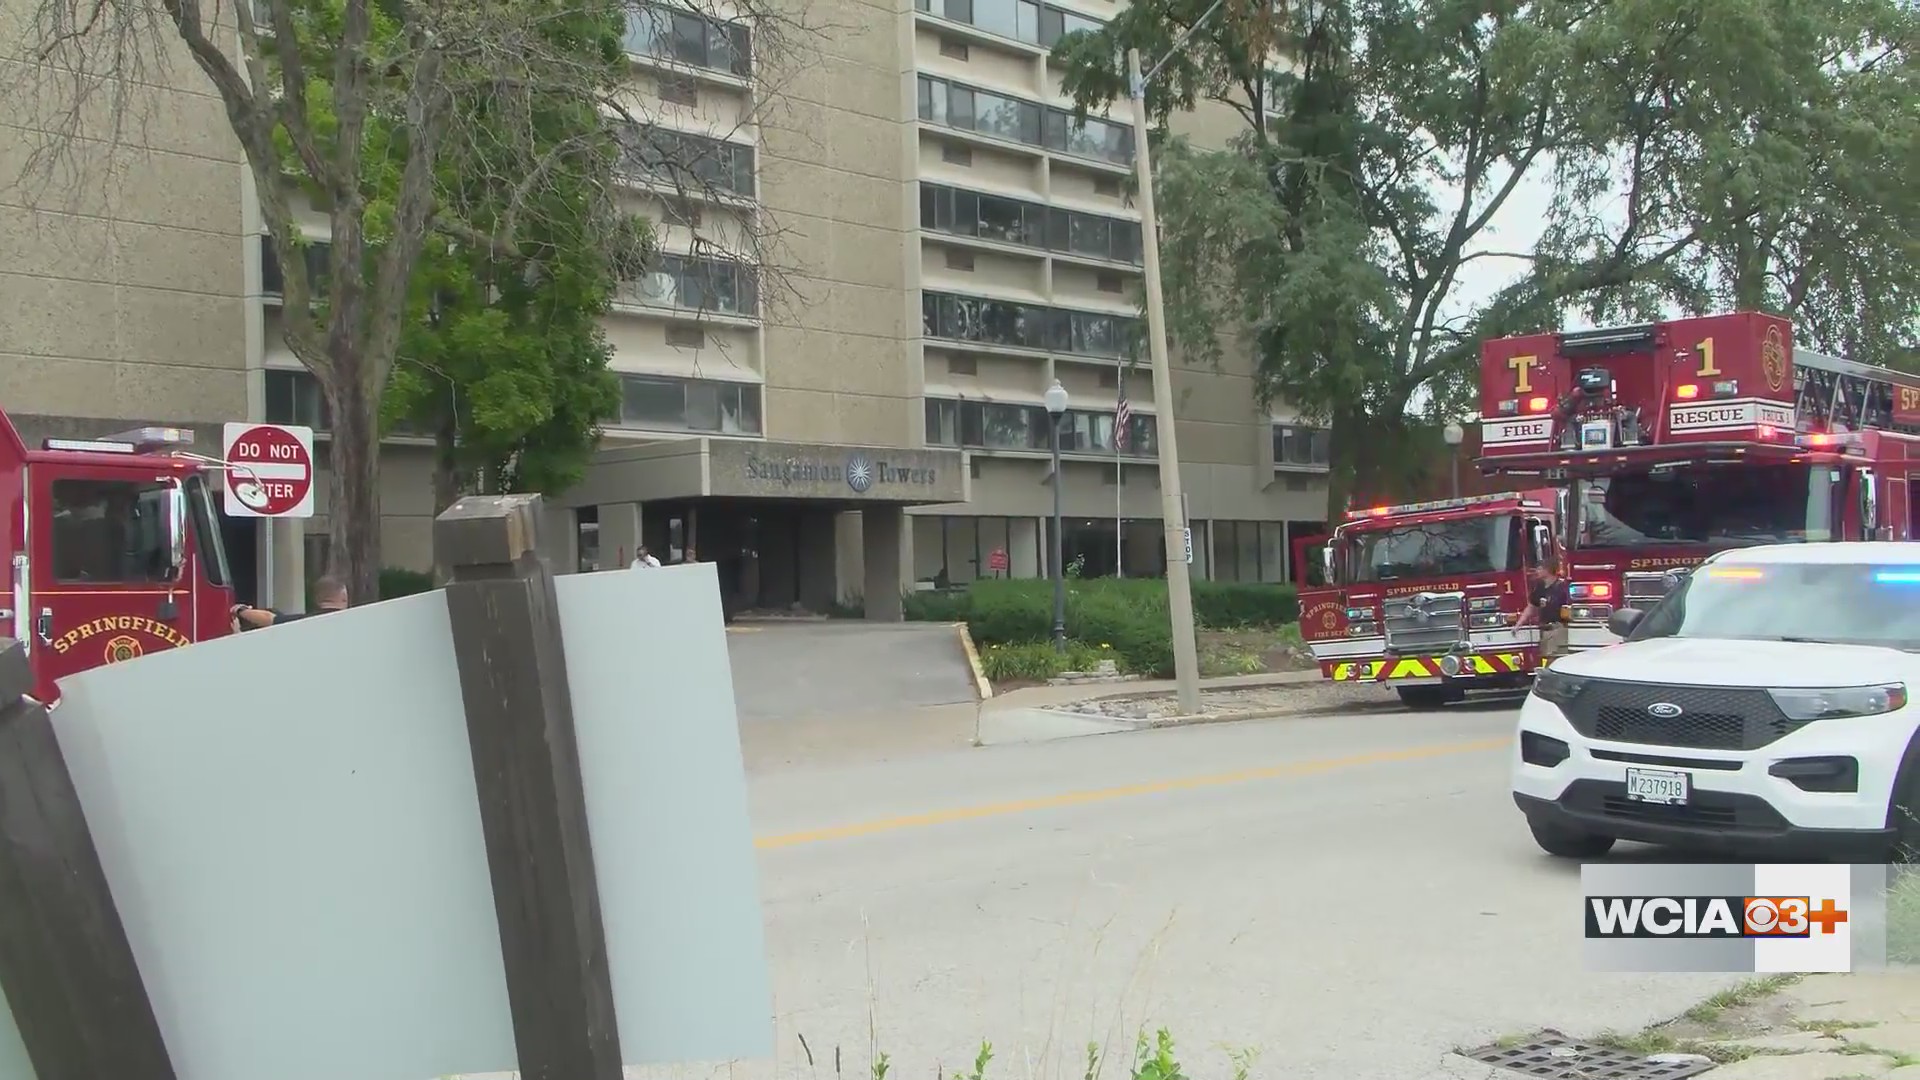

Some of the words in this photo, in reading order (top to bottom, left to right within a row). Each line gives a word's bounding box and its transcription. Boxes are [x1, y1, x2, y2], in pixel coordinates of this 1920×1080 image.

[1695, 336, 1721, 378] 1
[1508, 355, 1538, 393] T
[1672, 408, 1745, 425] RESCUE
[1501, 423, 1544, 437] FIRE
[239, 442, 260, 457] DO
[269, 444, 299, 459] NOT
[746, 455, 842, 487] Sangamon
[876, 461, 936, 485] Towers
[260, 484, 293, 498] TER
[1630, 557, 1705, 568] SPRINGF
[1386, 582, 1459, 596] SPRINGFIELD
[1503, 580, 1514, 594] 1
[1305, 601, 1345, 619] SPRINGFIE
[54, 616, 192, 654] SPRINGFIELD
